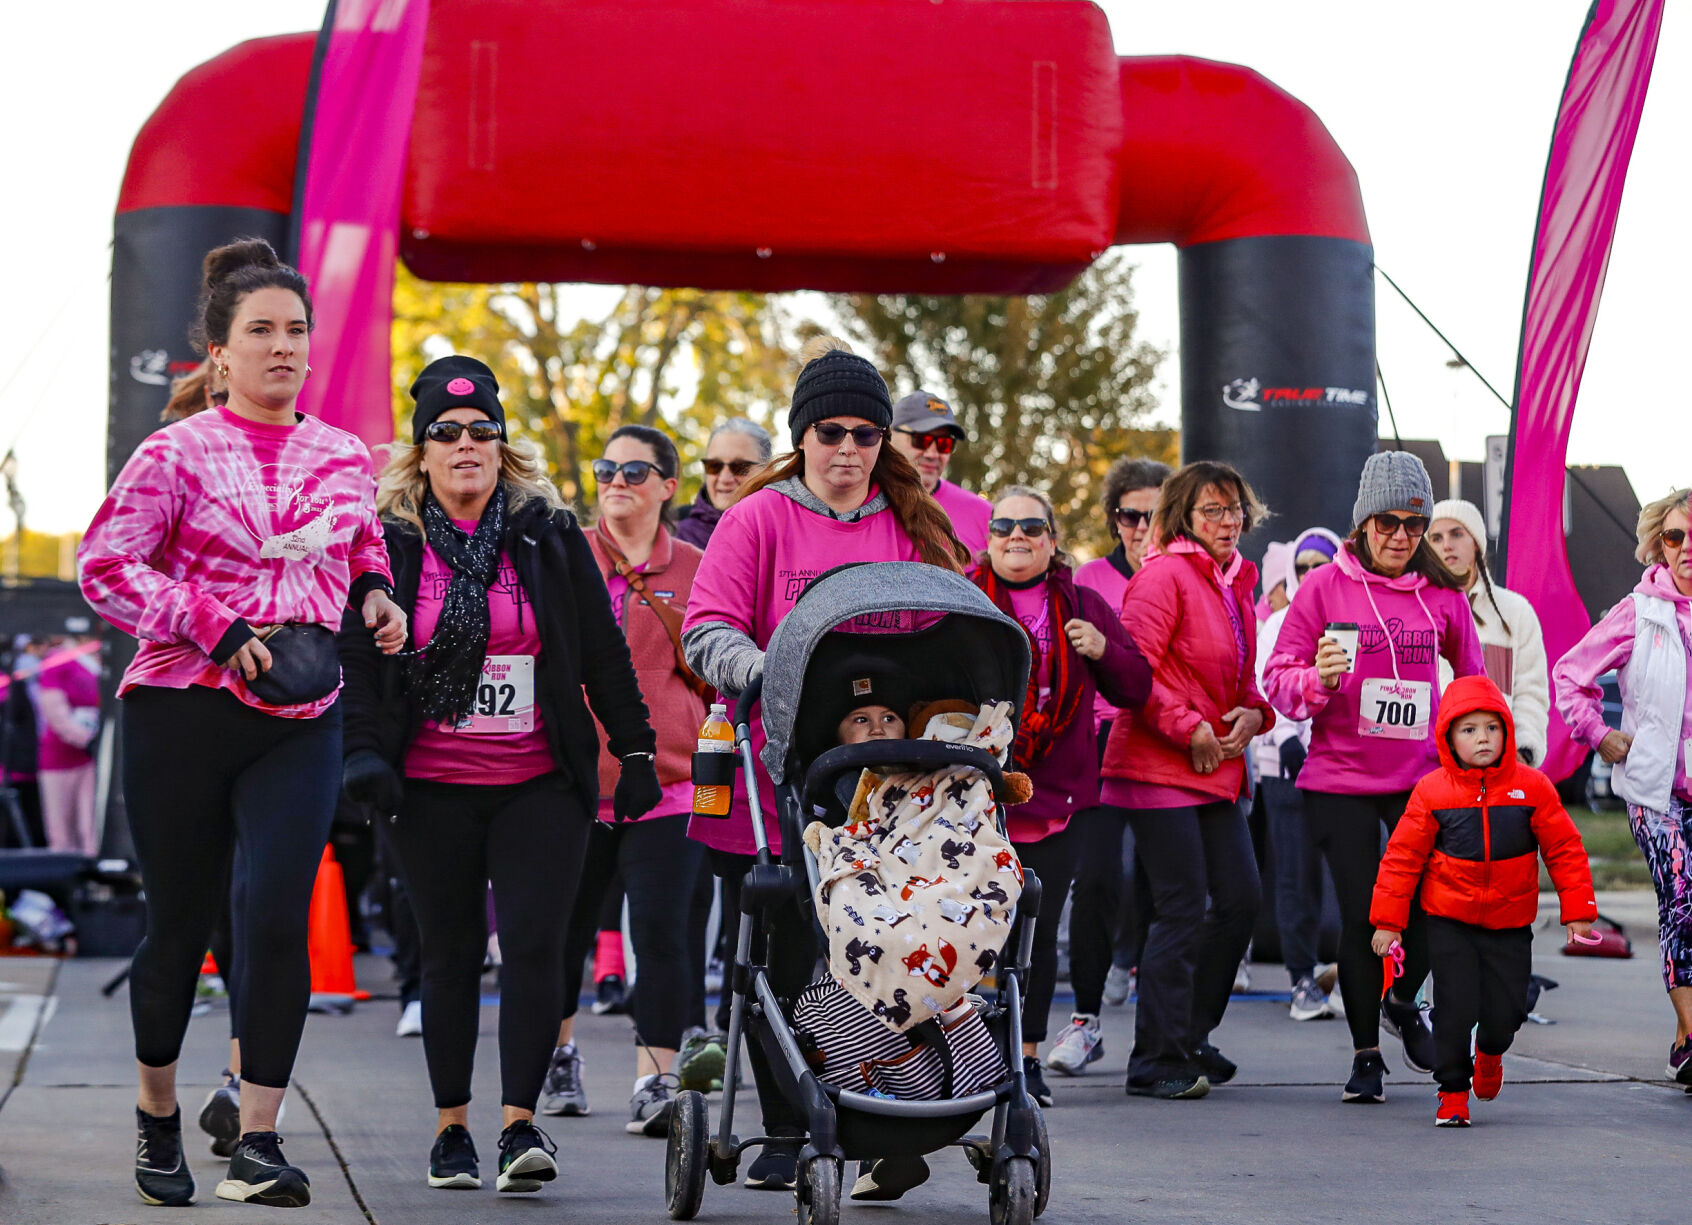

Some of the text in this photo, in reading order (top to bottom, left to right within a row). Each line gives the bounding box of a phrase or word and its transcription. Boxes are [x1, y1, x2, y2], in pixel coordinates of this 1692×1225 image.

[1325, 387, 1368, 405] TIME
[282, 543, 309, 553] ANNUAL
[1400, 647, 1430, 665] RUN
[491, 672, 507, 681] RUN
[478, 683, 516, 716] 92
[1375, 699, 1417, 727] 700
